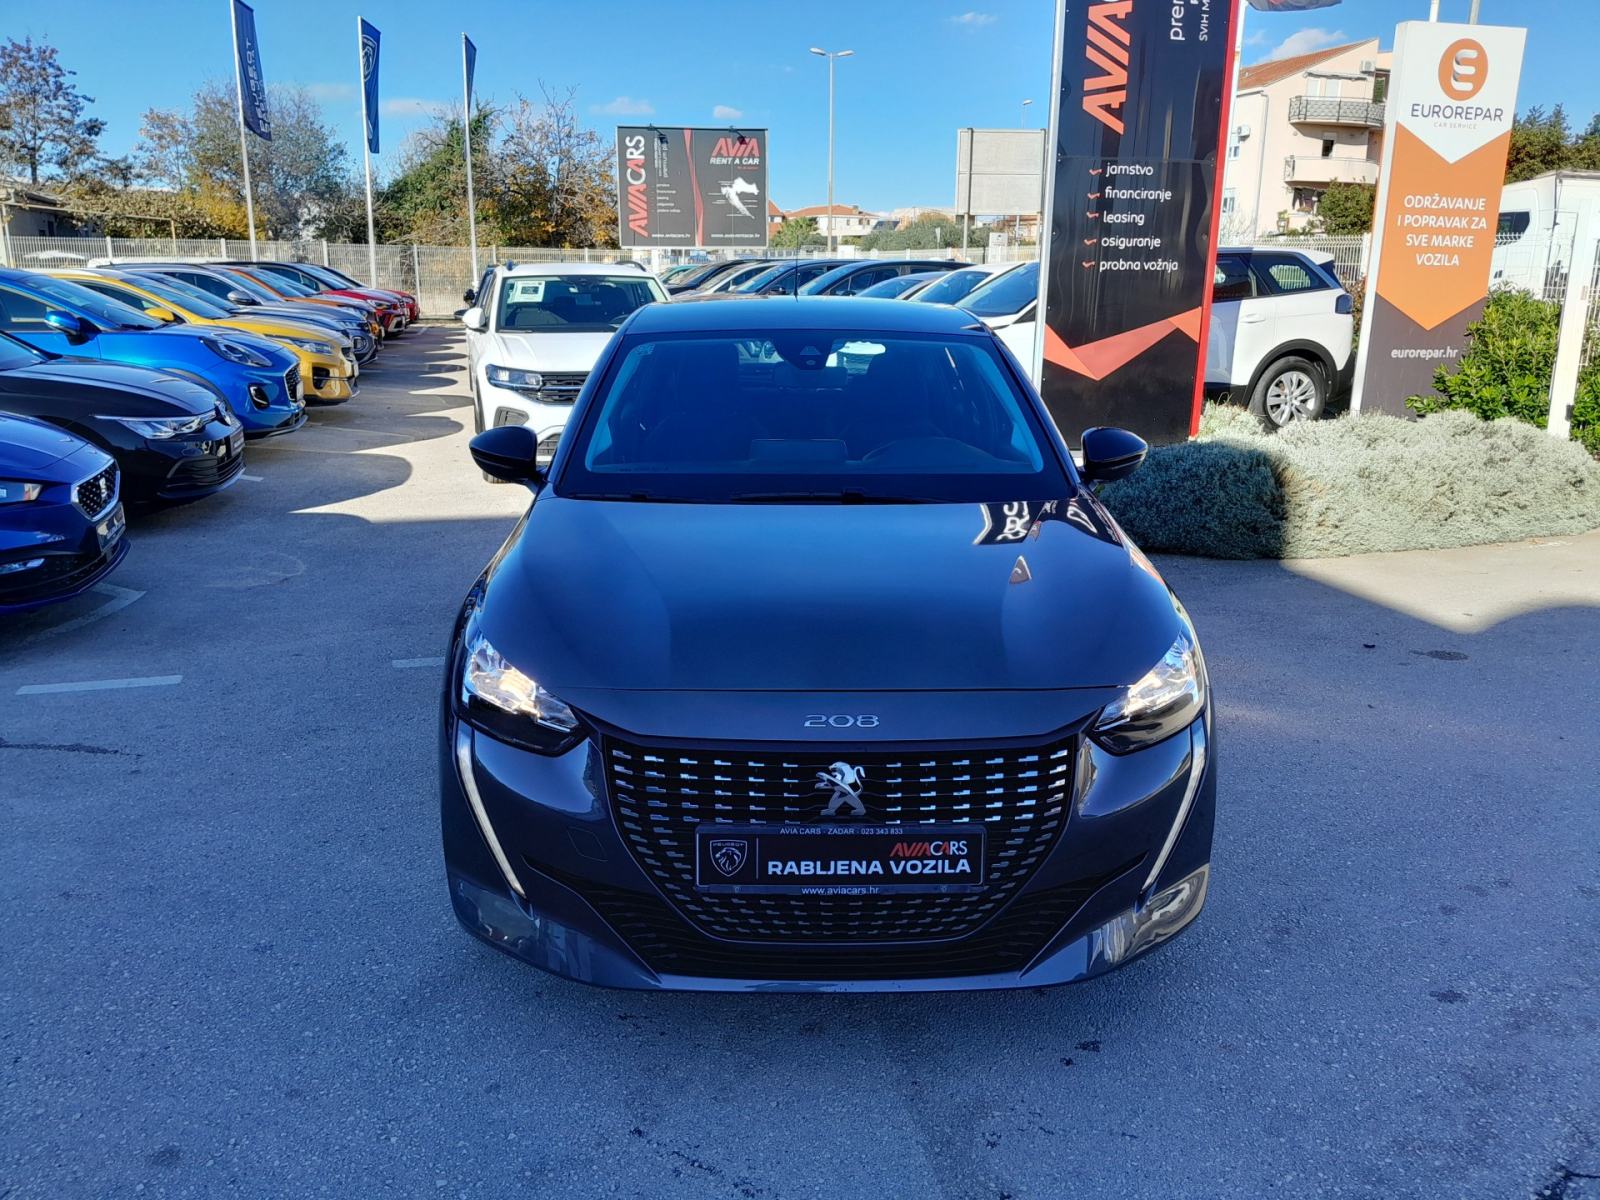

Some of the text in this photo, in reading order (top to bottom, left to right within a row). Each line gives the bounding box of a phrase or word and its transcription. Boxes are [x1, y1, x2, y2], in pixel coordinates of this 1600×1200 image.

[1198, 14, 1209, 42] SVIH
[1410, 103, 1504, 122] EUROREPAR
[1449, 122, 1478, 130] SERVICE
[711, 137, 760, 157] AVIA
[710, 157, 760, 165] RENT A CAR
[1105, 163, 1154, 177] jamstvo
[625, 135, 649, 238] AVIACARS
[1104, 186, 1172, 202] financiranje
[1404, 193, 1486, 210] ODRŽAVANJE
[1103, 210, 1145, 226] leasing
[1397, 214, 1487, 229] I POPRAVAK ZA
[1101, 235, 1161, 250] osiguranje
[1406, 233, 1474, 248] SVE MARKE
[1100, 258, 1178, 273] probna vožnja
[1416, 253, 1460, 266] VOZILA
[1391, 346, 1458, 360] eurorepar.hr
[803, 714, 880, 727] 208
[890, 841, 968, 857] AVIACARS
[767, 858, 971, 876] RABLJENA VOZILA
[801, 886, 880, 895] www.aviacars.hr
